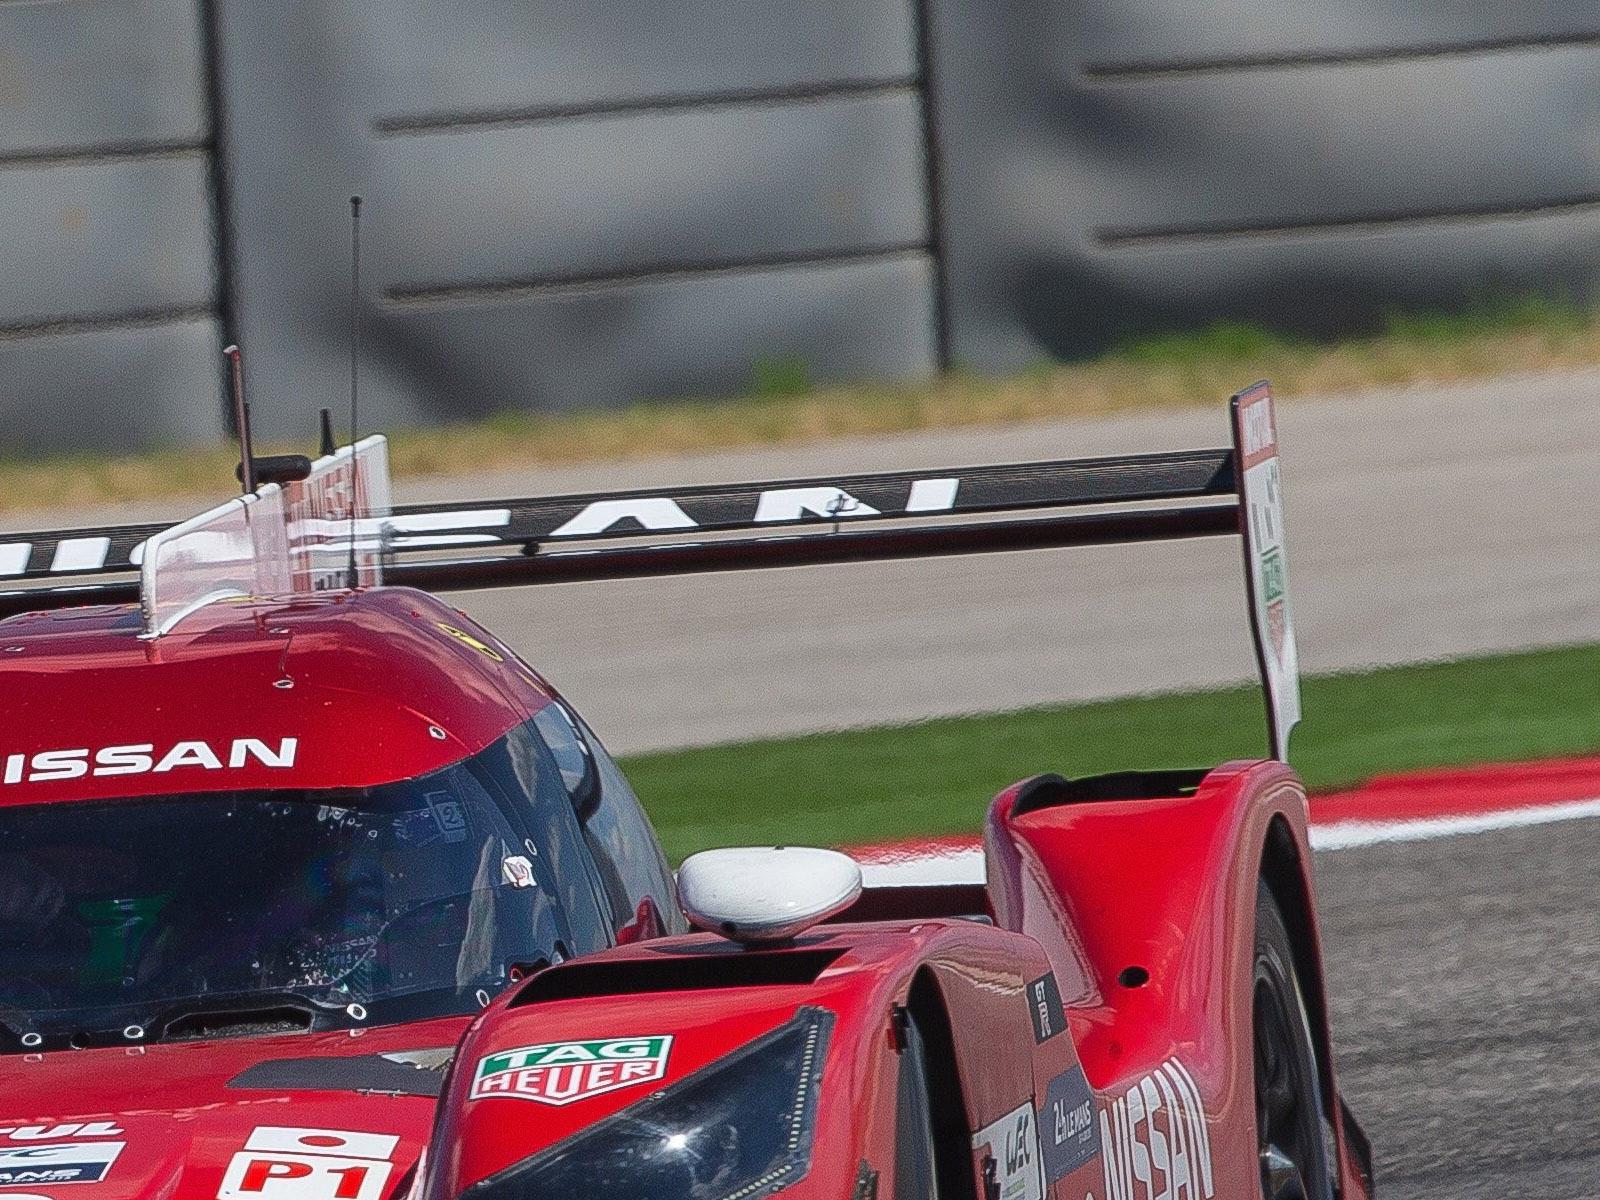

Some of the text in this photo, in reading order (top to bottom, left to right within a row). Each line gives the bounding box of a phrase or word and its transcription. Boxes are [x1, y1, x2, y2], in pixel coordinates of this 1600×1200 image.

[493, 1040, 653, 1070] TAG
[480, 1061, 654, 1098] HEUER
[1006, 1113, 1031, 1177] WEC
[236, 1158, 369, 1200] P1
